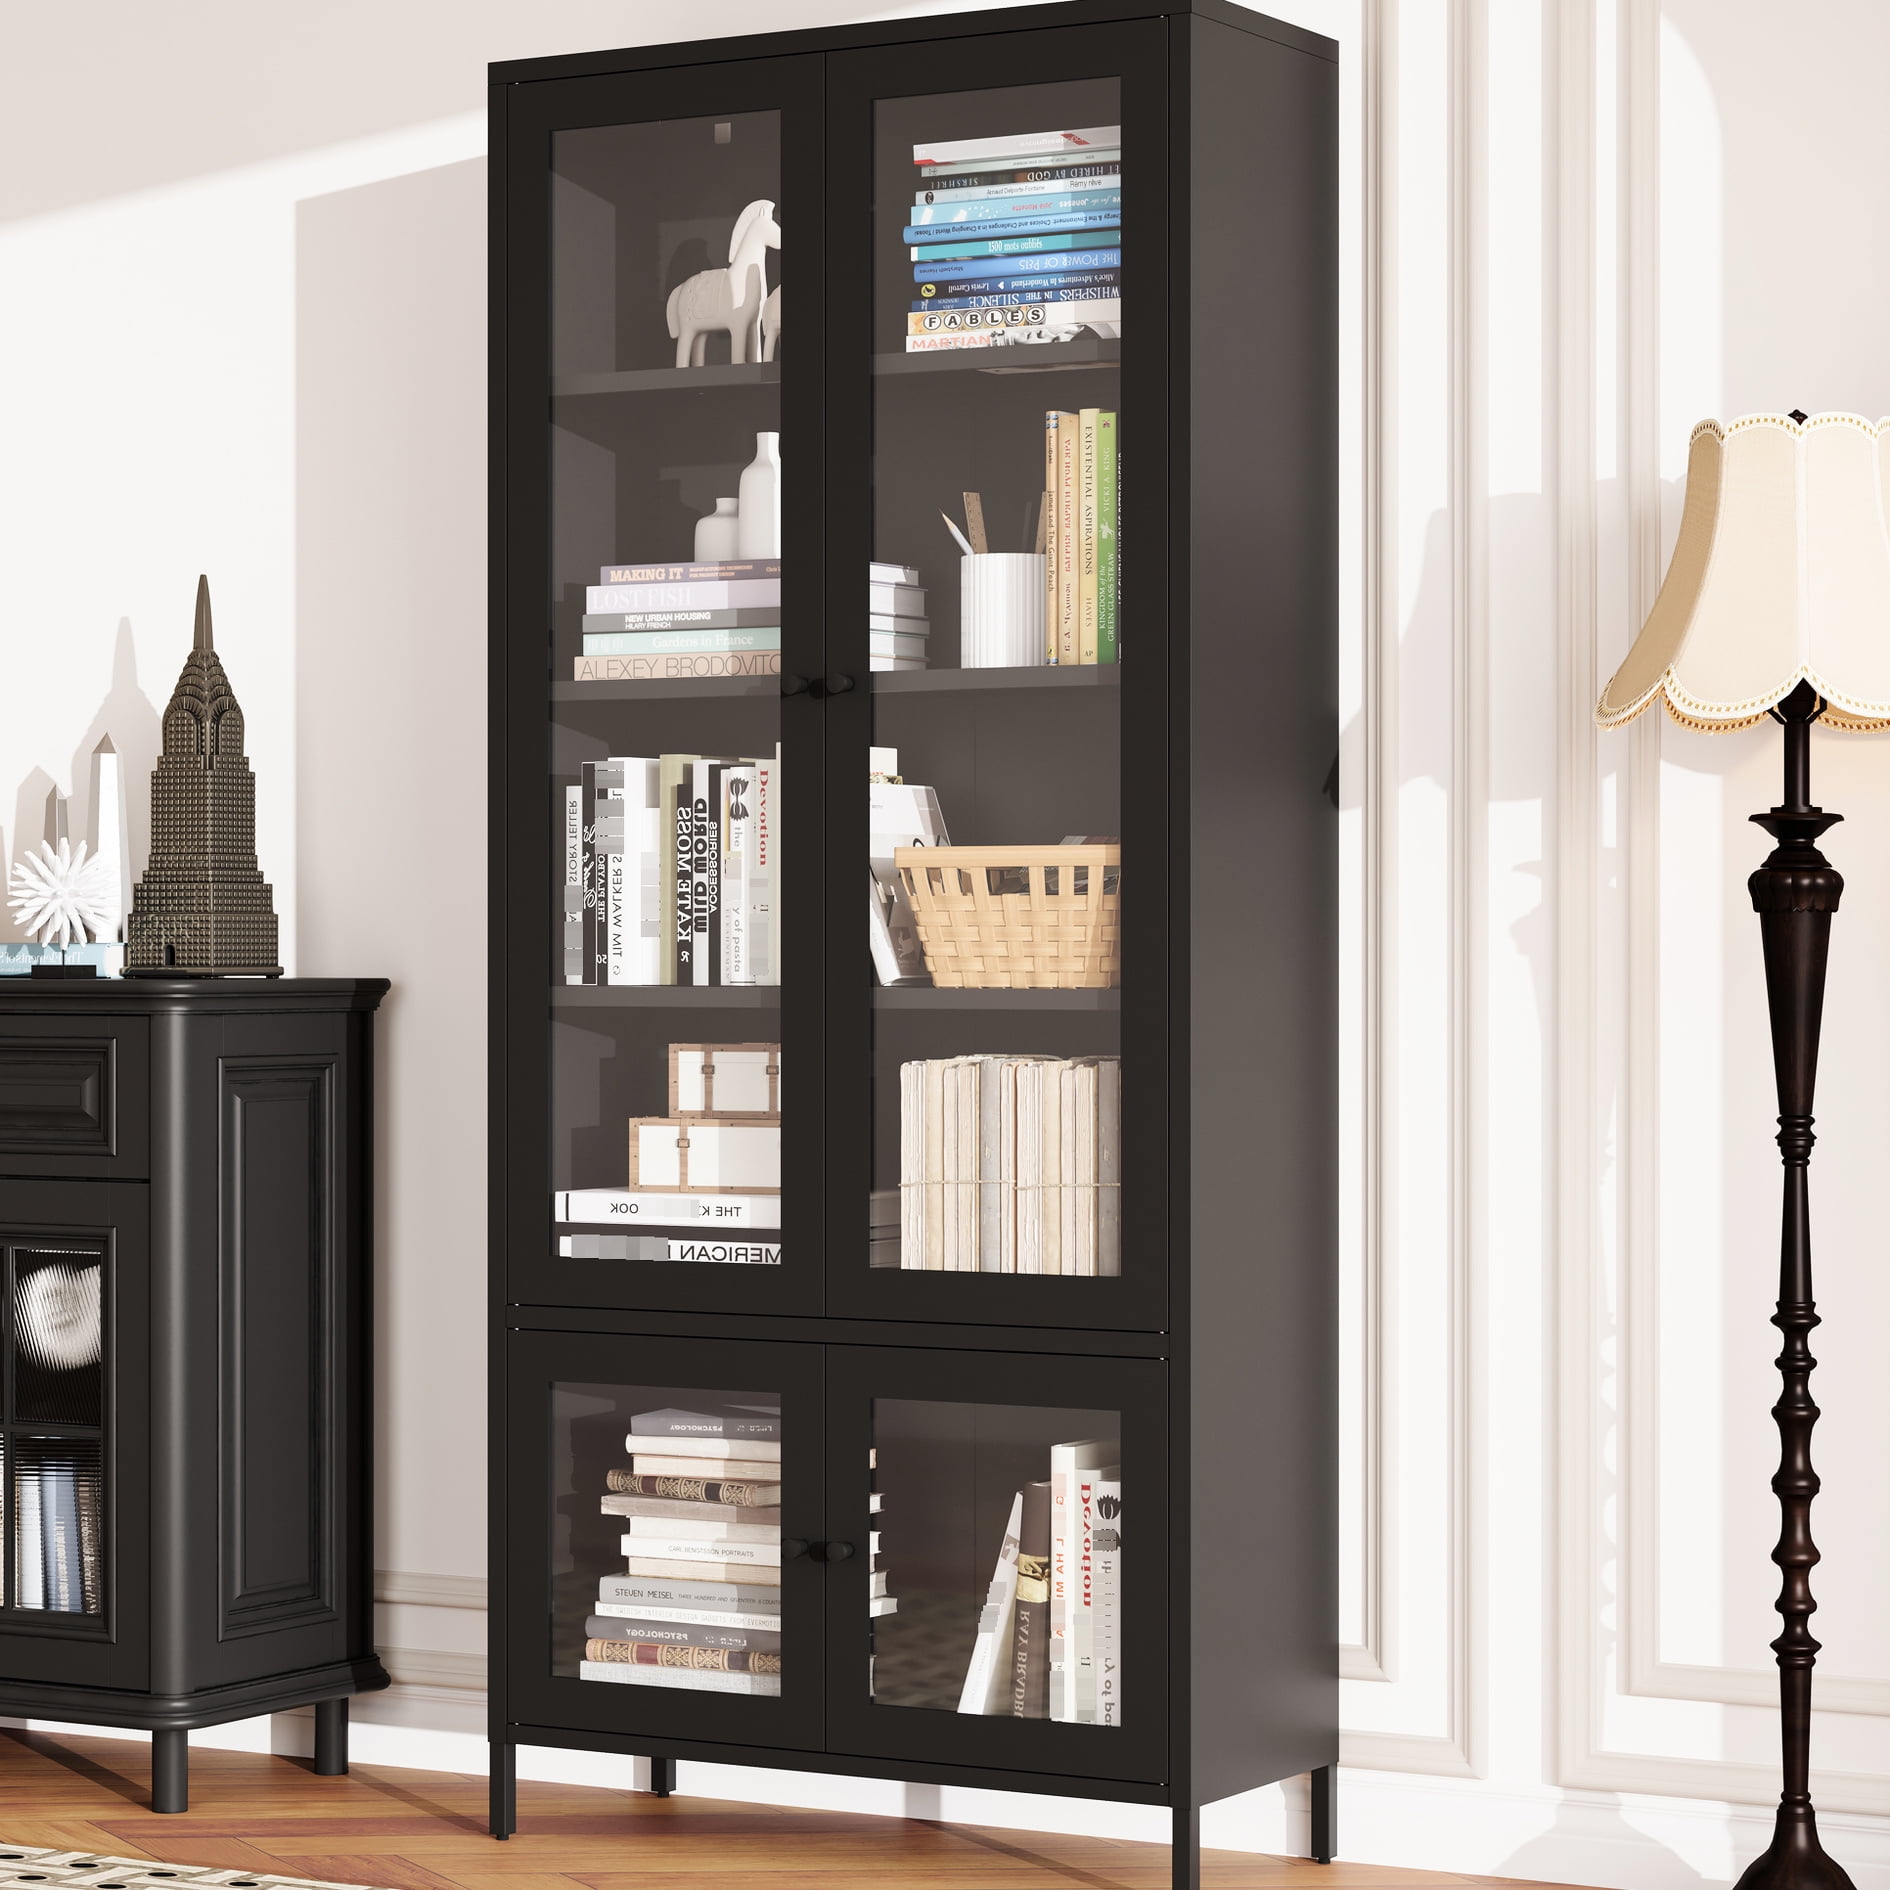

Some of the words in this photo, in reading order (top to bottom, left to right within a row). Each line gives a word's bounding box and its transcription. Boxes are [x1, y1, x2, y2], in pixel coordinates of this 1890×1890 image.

[1055, 168, 1066, 179] BY
[1070, 165, 1104, 178] HIRED
[1109, 164, 1120, 173] ET
[1027, 170, 1051, 182] GOD
[1059, 198, 1088, 209] Joneses
[989, 221, 1018, 230] Challenges
[1029, 219, 1051, 228] Choices
[1052, 216, 1087, 225] Environment:
[935, 227, 951, 235] World
[951, 224, 976, 234] Changing
[988, 242, 1003, 253] 1500
[1004, 241, 1018, 250] mots
[1011, 278, 1049, 288] Wonderland
[1058, 275, 1092, 285] Adventures
[1093, 274, 1114, 284] Alice's
[949, 284, 970, 293] Carroll
[971, 281, 989, 291] Lewis
[1025, 291, 1042, 300] THE
[1043, 290, 1053, 299] IN
[1059, 286, 1119, 300] WHISPERS
[968, 292, 1020, 308] SILENCE
[929, 309, 1040, 328] FABLES
[912, 336, 991, 350] MARTIAN
[1085, 426, 1093, 500] EXISTENTIAL
[1104, 475, 1110, 484] A.
[1047, 490, 1055, 512] James
[1085, 504, 1093, 575] ASPIRATIONS
[610, 568, 666, 582] MAKING
[668, 567, 684, 580] IT
[1100, 578, 1106, 587] of
[592, 588, 643, 609] LOST
[648, 586, 692, 608] FISH
[625, 614, 644, 623] NEW
[645, 612, 672, 622] URBAN
[674, 611, 711, 621] HOUSING
[625, 622, 645, 630] HILARY
[646, 621, 671, 629] FRENCH
[652, 635, 698, 648] Gardens
[701, 635, 711, 646] in
[716, 634, 753, 646] France
[580, 658, 659, 680] ALEXEY
[665, 654, 781, 677] BRODOVITC
[760, 770, 769, 866] Devotion
[734, 826, 742, 848] the
[734, 919, 743, 934] of
[732, 936, 742, 973] pasta
[670, 1424, 723, 1432] PSYCHOLOGY
[721, 1549, 754, 1557] PORTRAITS
[615, 1588, 644, 1598] STEVEN
[647, 1590, 674, 1600] MEISEL
[602, 1605, 614, 1613] THE
[617, 1607, 641, 1616] SWEDISH
[676, 1611, 698, 1620] DESIGN
